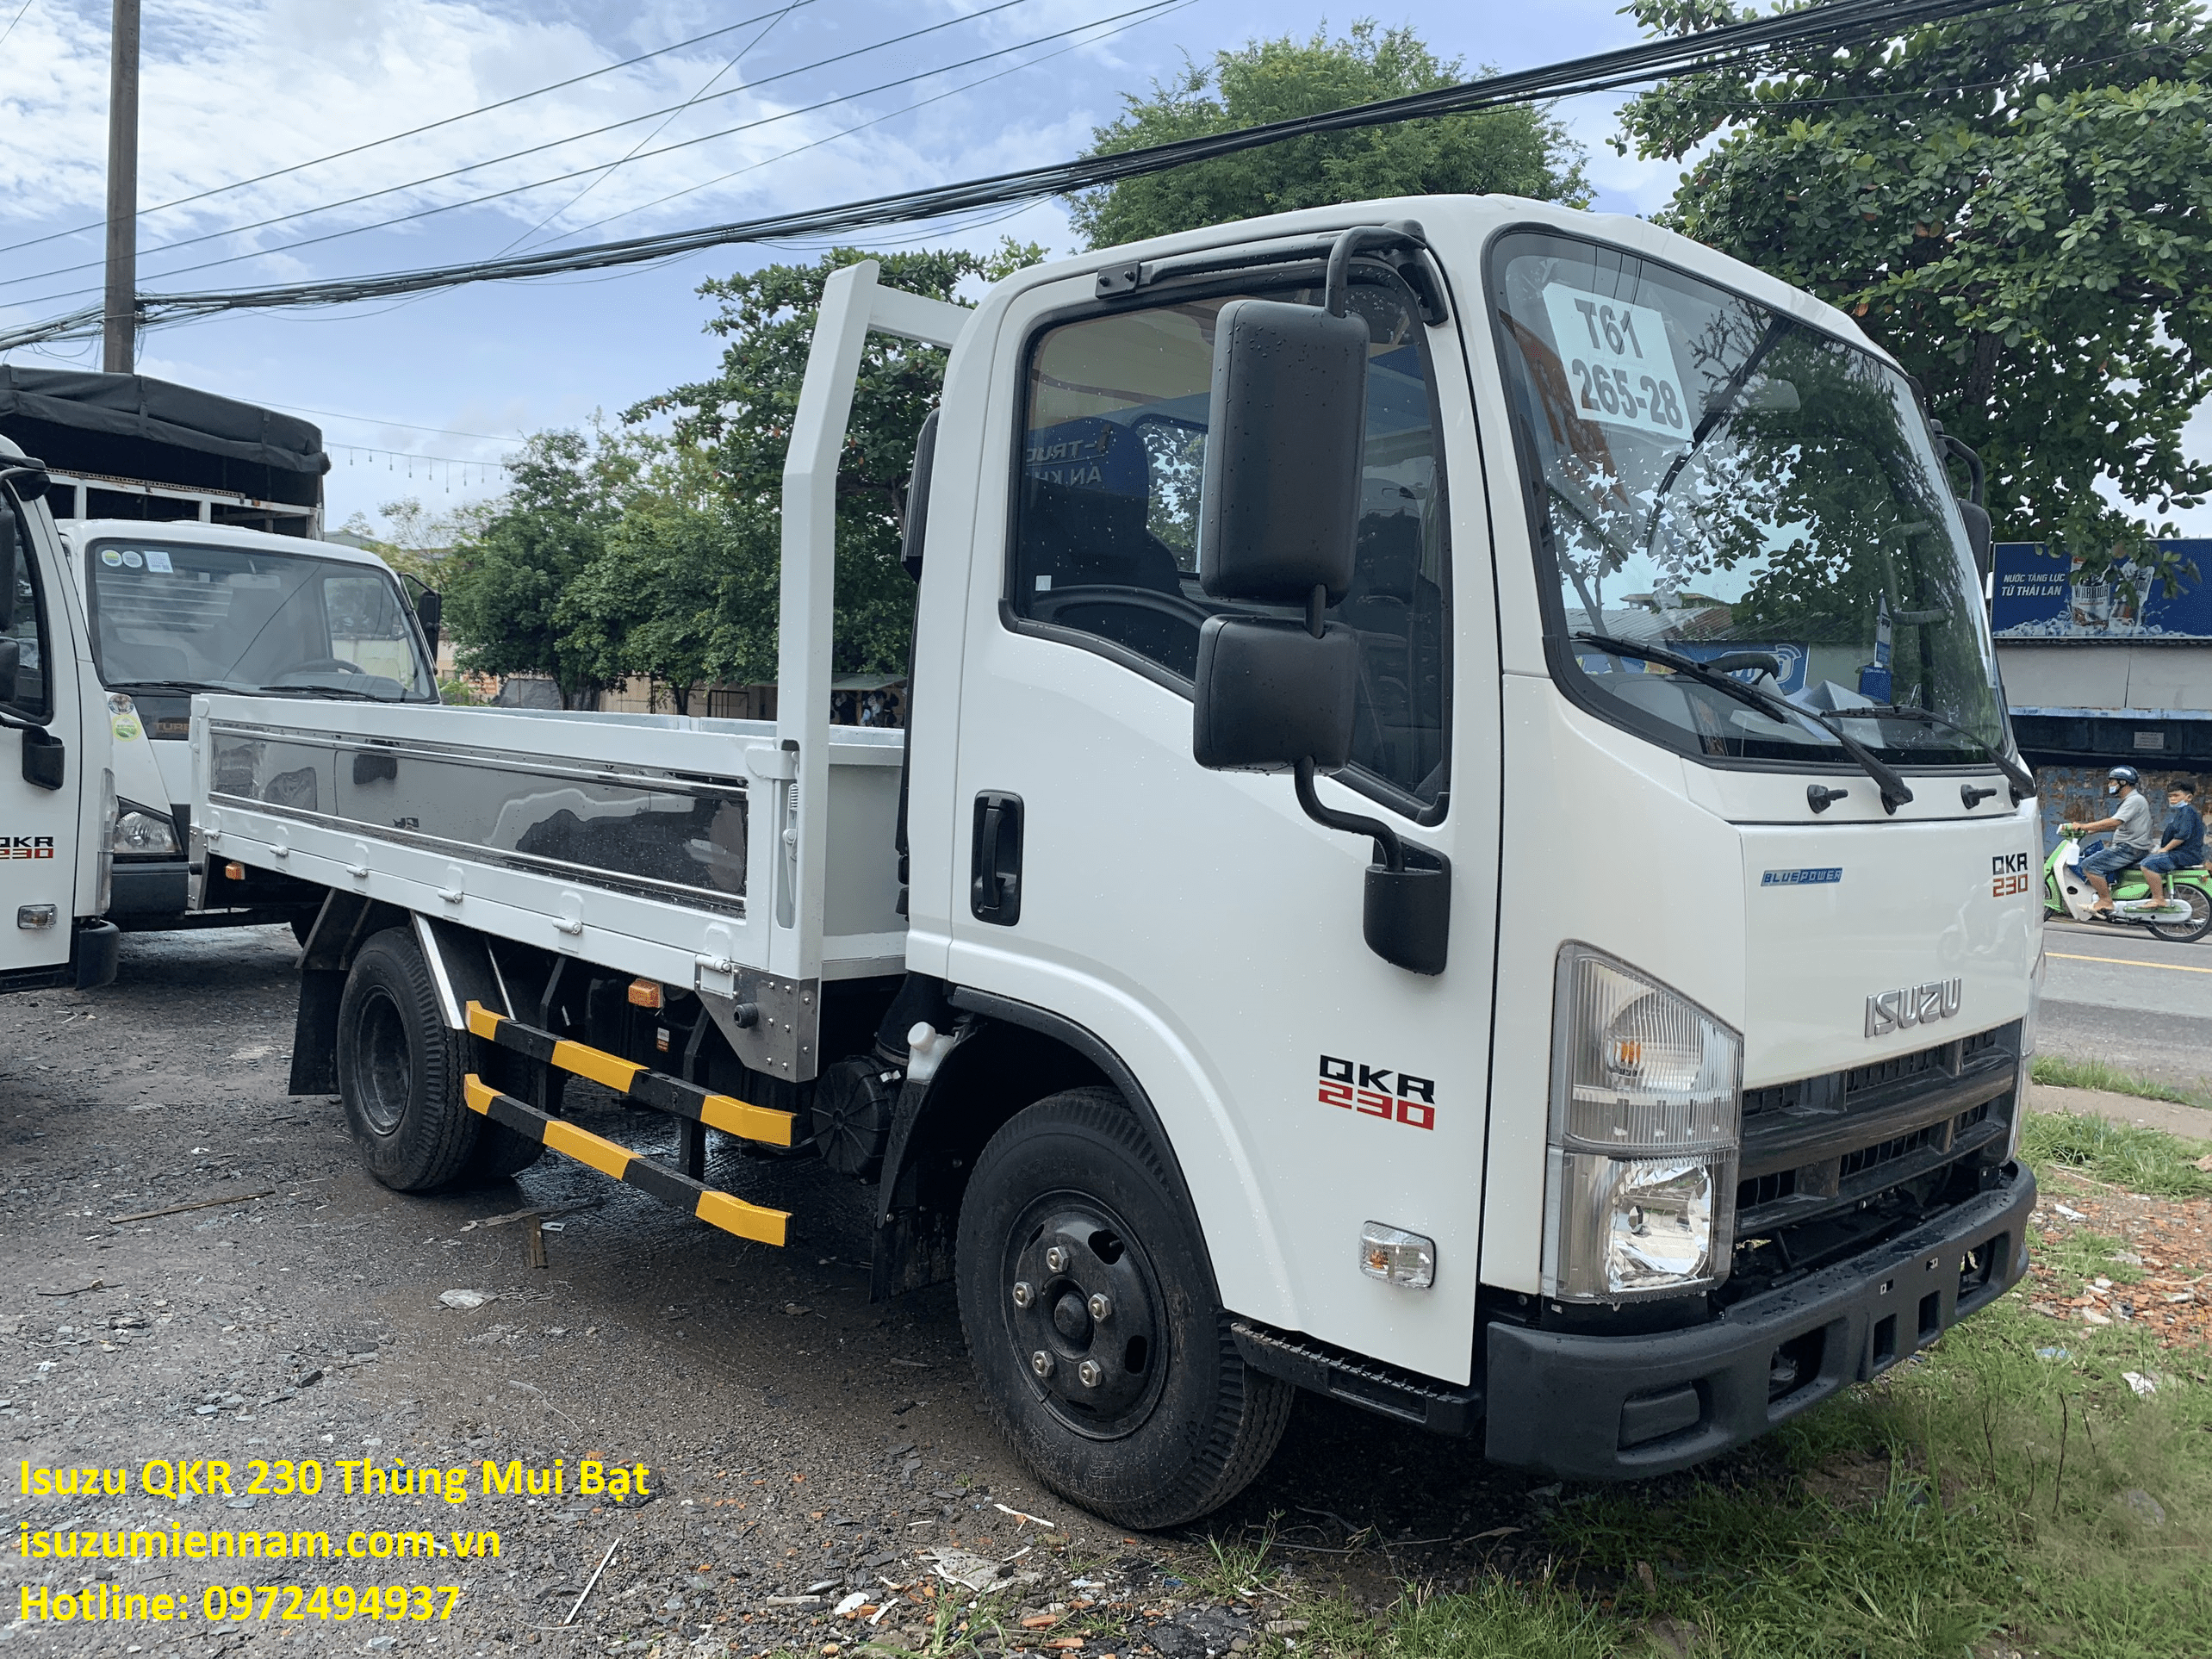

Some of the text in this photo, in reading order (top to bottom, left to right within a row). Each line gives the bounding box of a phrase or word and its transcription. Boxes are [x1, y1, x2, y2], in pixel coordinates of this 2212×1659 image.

[1574, 297, 1644, 359] T61
[1571, 357, 1684, 431] 265-28
[2016, 584, 2040, 596] THÁI
[2041, 586, 2063, 596] LAN
[2074, 585, 2109, 599] WARRIOR
[1991, 852, 2029, 876] QKR
[1991, 873, 2029, 898] 230
[1864, 976, 1963, 1039] ISUZU
[1318, 1078, 1435, 1131] 230
[1319, 1053, 1436, 1105] QKR
